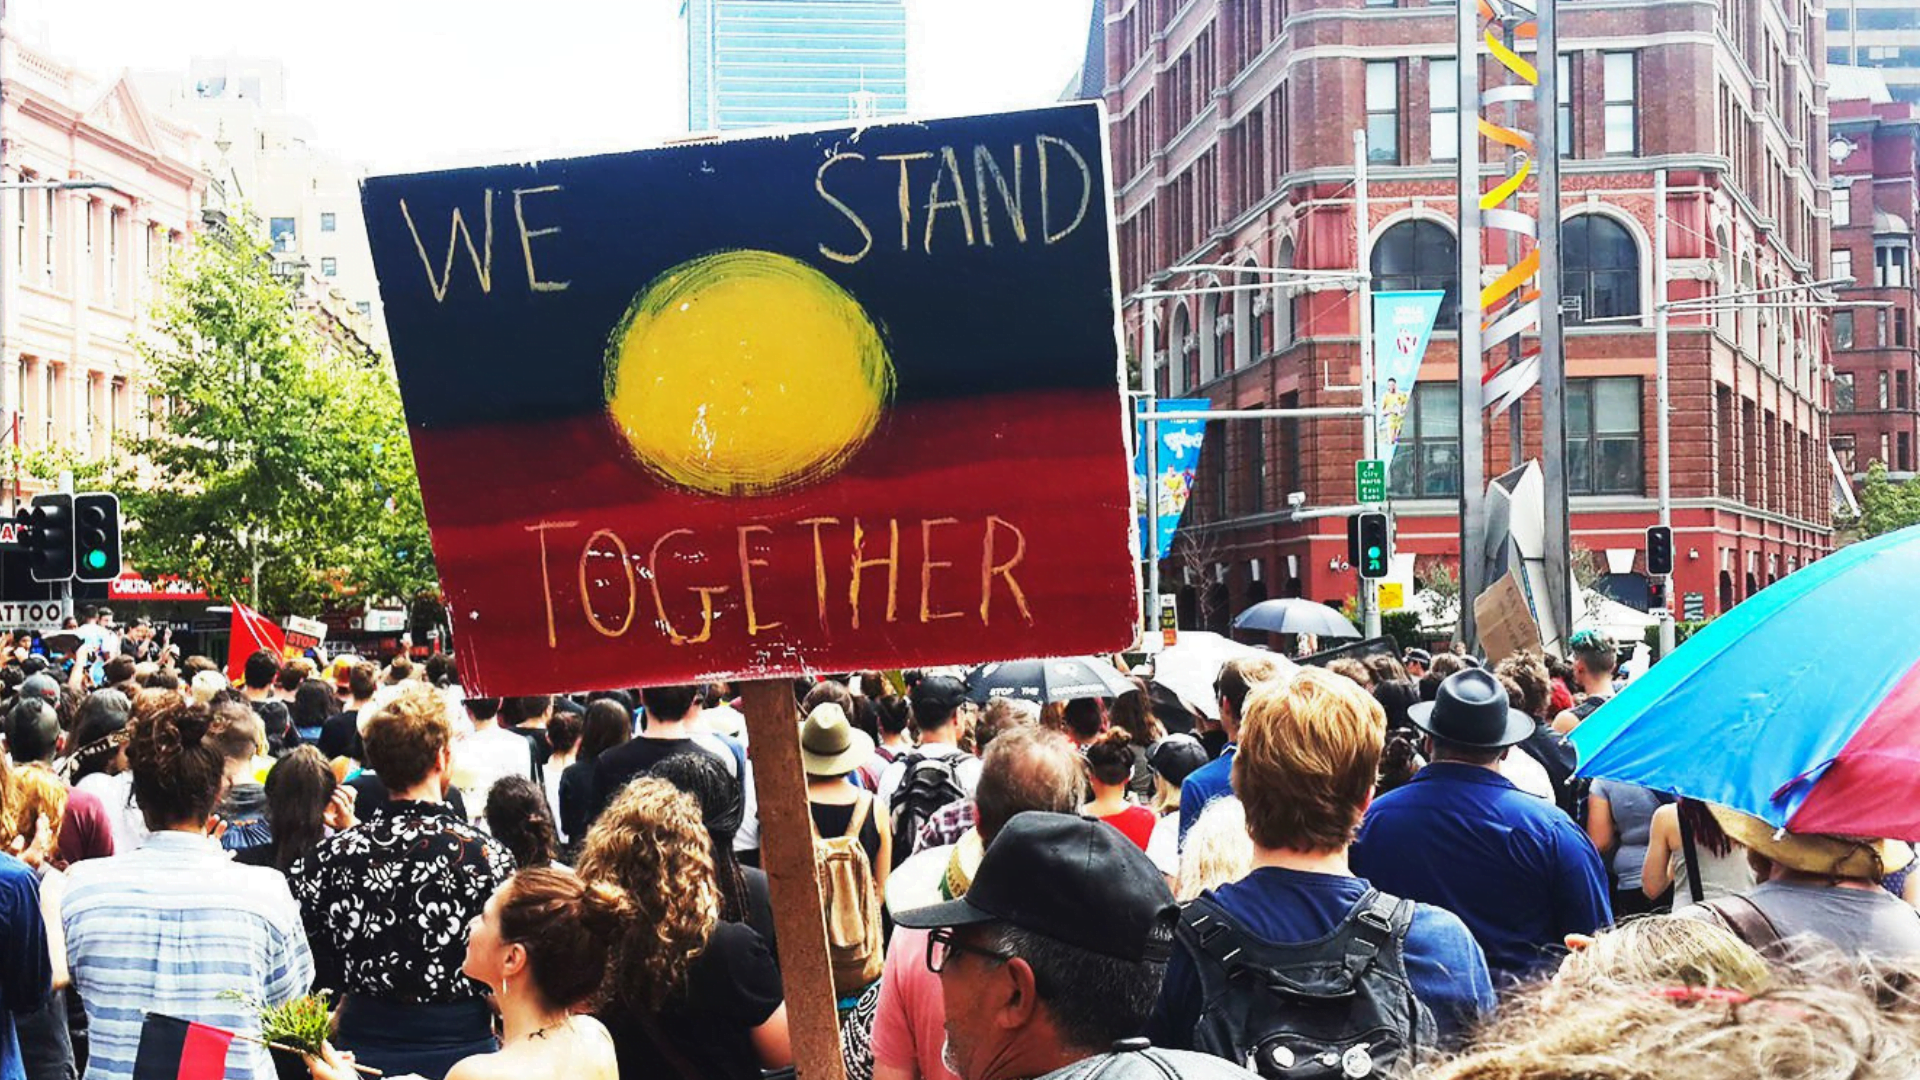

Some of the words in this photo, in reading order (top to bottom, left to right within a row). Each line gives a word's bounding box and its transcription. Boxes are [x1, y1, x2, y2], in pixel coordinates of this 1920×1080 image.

[399, 185, 570, 303] WE
[816, 135, 1091, 264] STAND
[1362, 471, 1379, 479] City
[524, 514, 1034, 648] TOGETHER
[0, 604, 61, 622] TTOO
[287, 632, 318, 648] STOP
[990, 687, 1015, 696] STOP
[1021, 687, 1040, 696] THE
